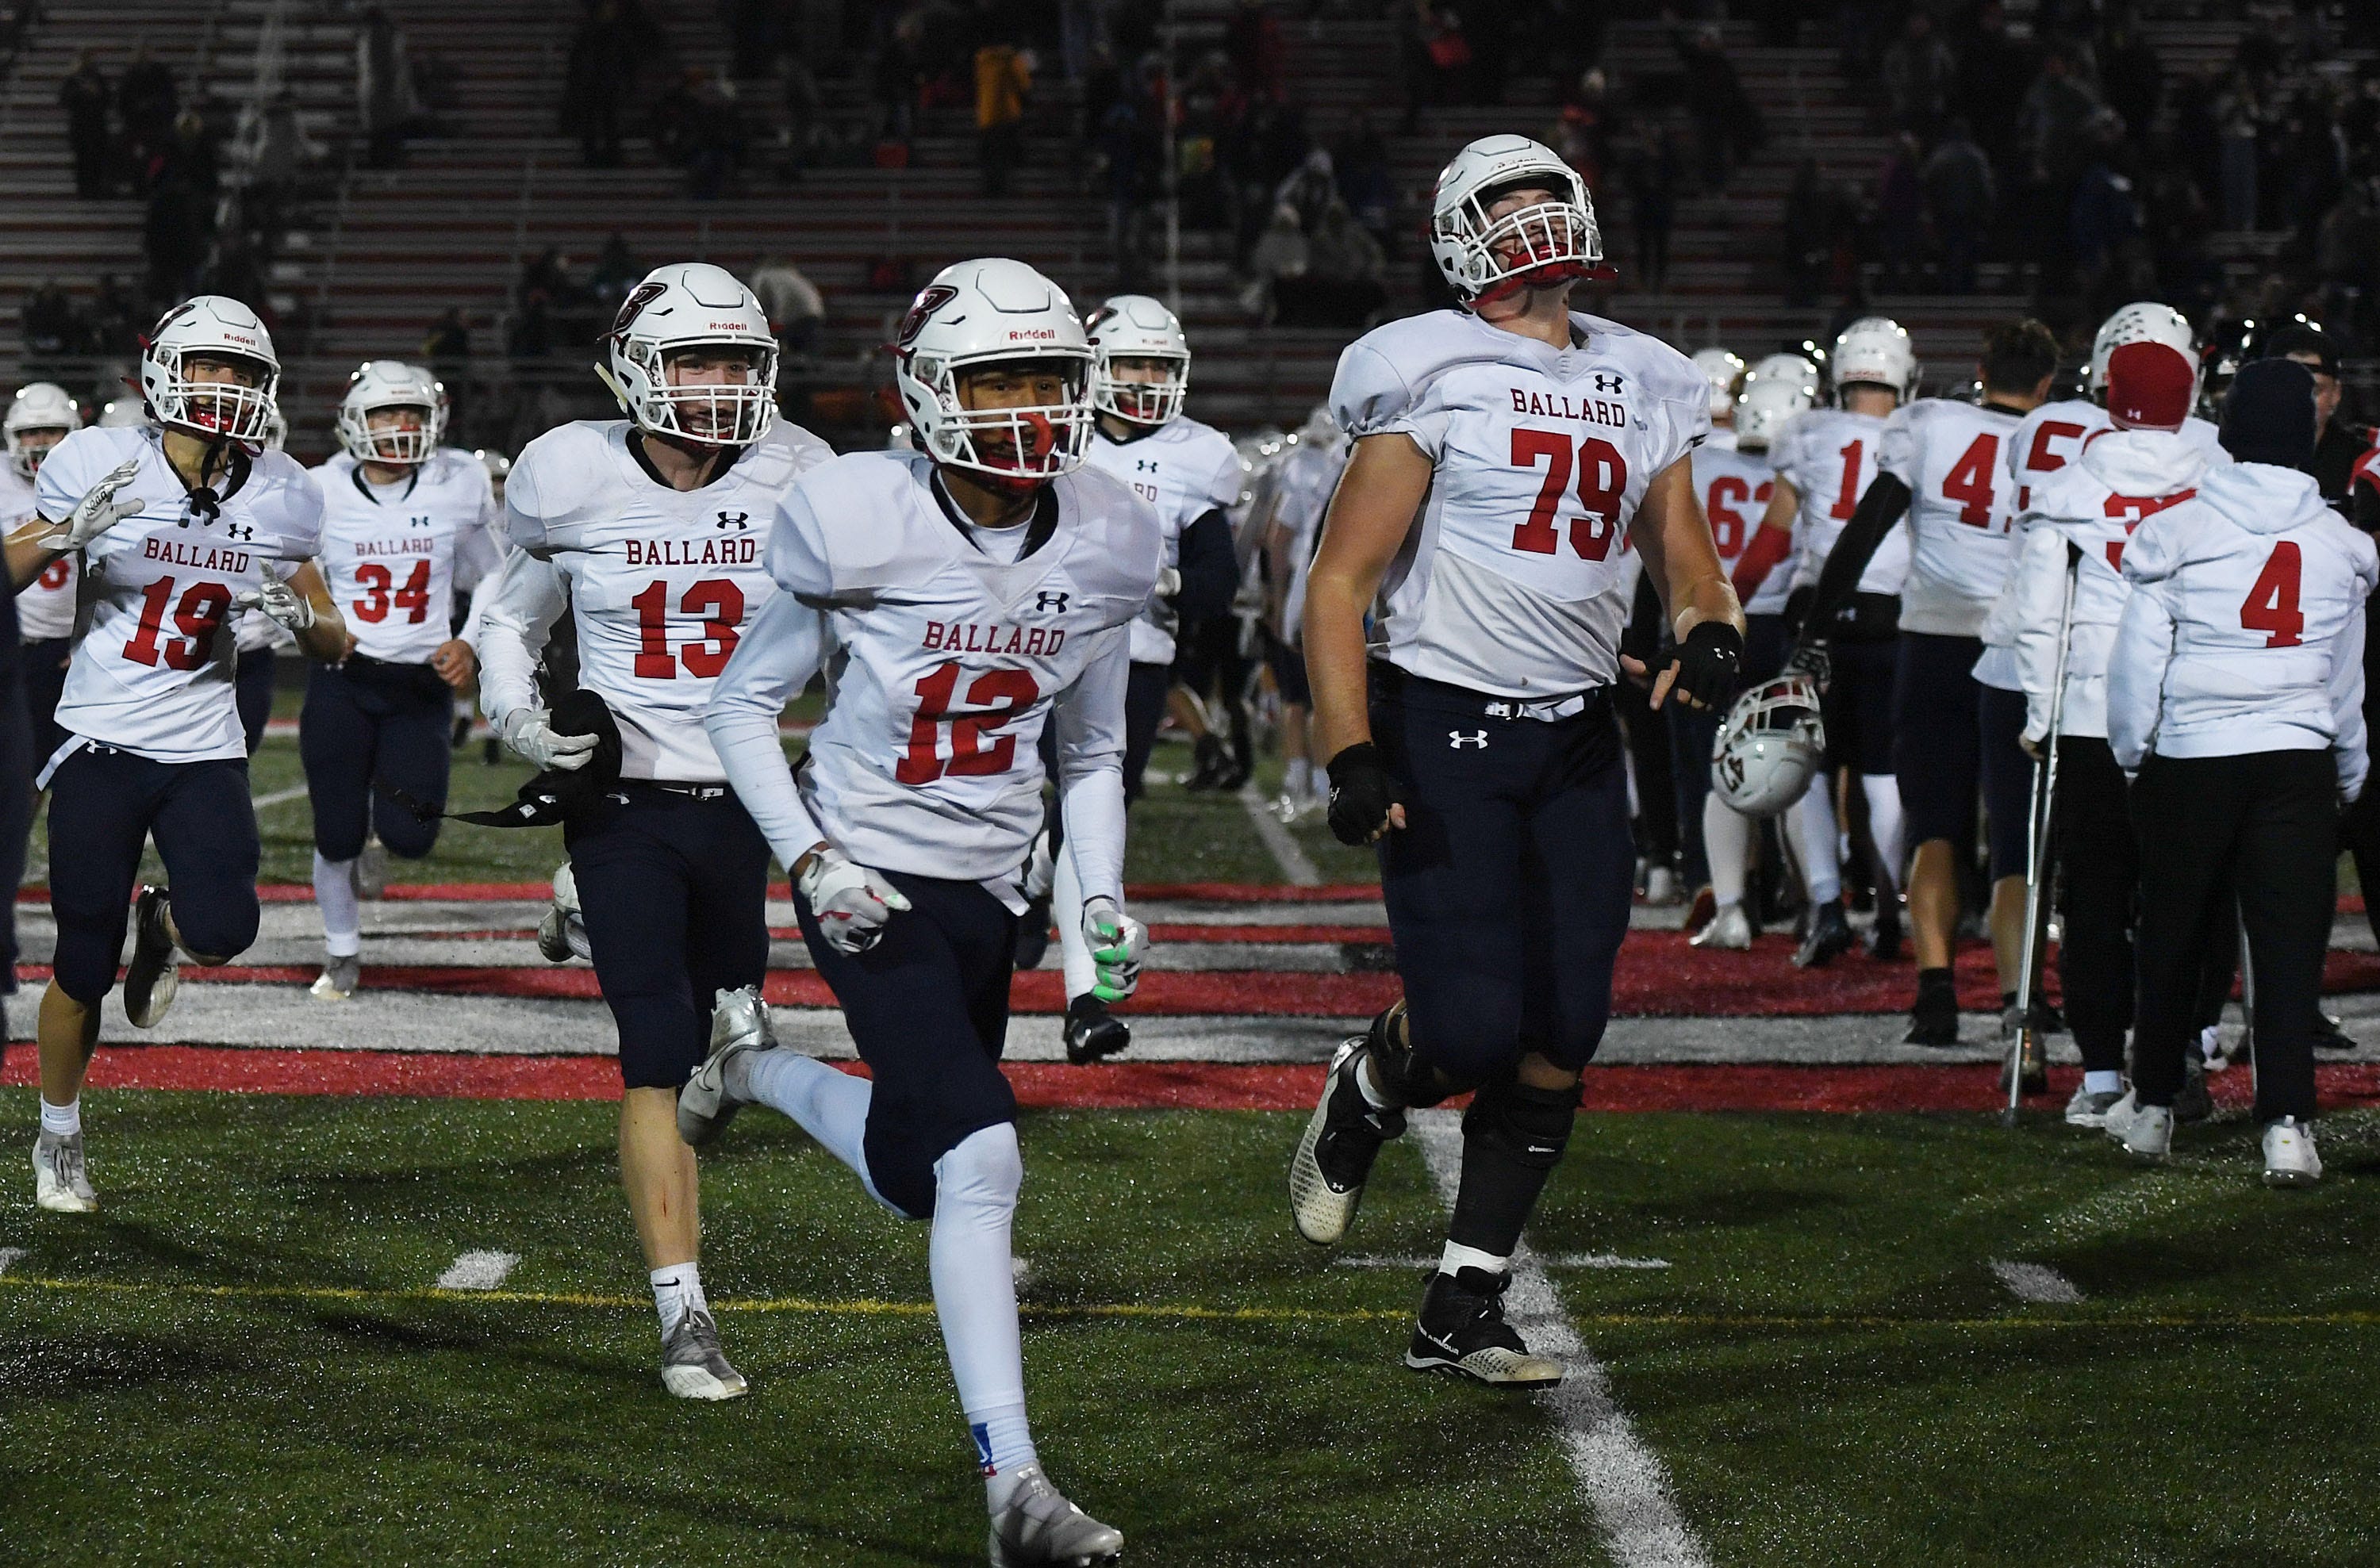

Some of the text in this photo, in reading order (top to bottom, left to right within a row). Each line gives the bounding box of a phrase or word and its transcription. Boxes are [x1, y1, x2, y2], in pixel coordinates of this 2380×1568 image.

[224, 333, 255, 347] Riddell
[1009, 329, 1055, 340] Riddell
[1510, 388, 1626, 428] BALLARD
[1511, 428, 1627, 562] 79
[1942, 432, 2013, 533] 4
[144, 538, 249, 573] BALLARD
[355, 538, 434, 555] BALLARD
[625, 539, 755, 565] BALLARD
[352, 559, 430, 624] 34
[2240, 541, 2304, 648] 4
[122, 576, 232, 670] 19
[631, 579, 744, 679] 13
[923, 621, 1065, 657] BALLARD
[896, 663, 1039, 784] 12
